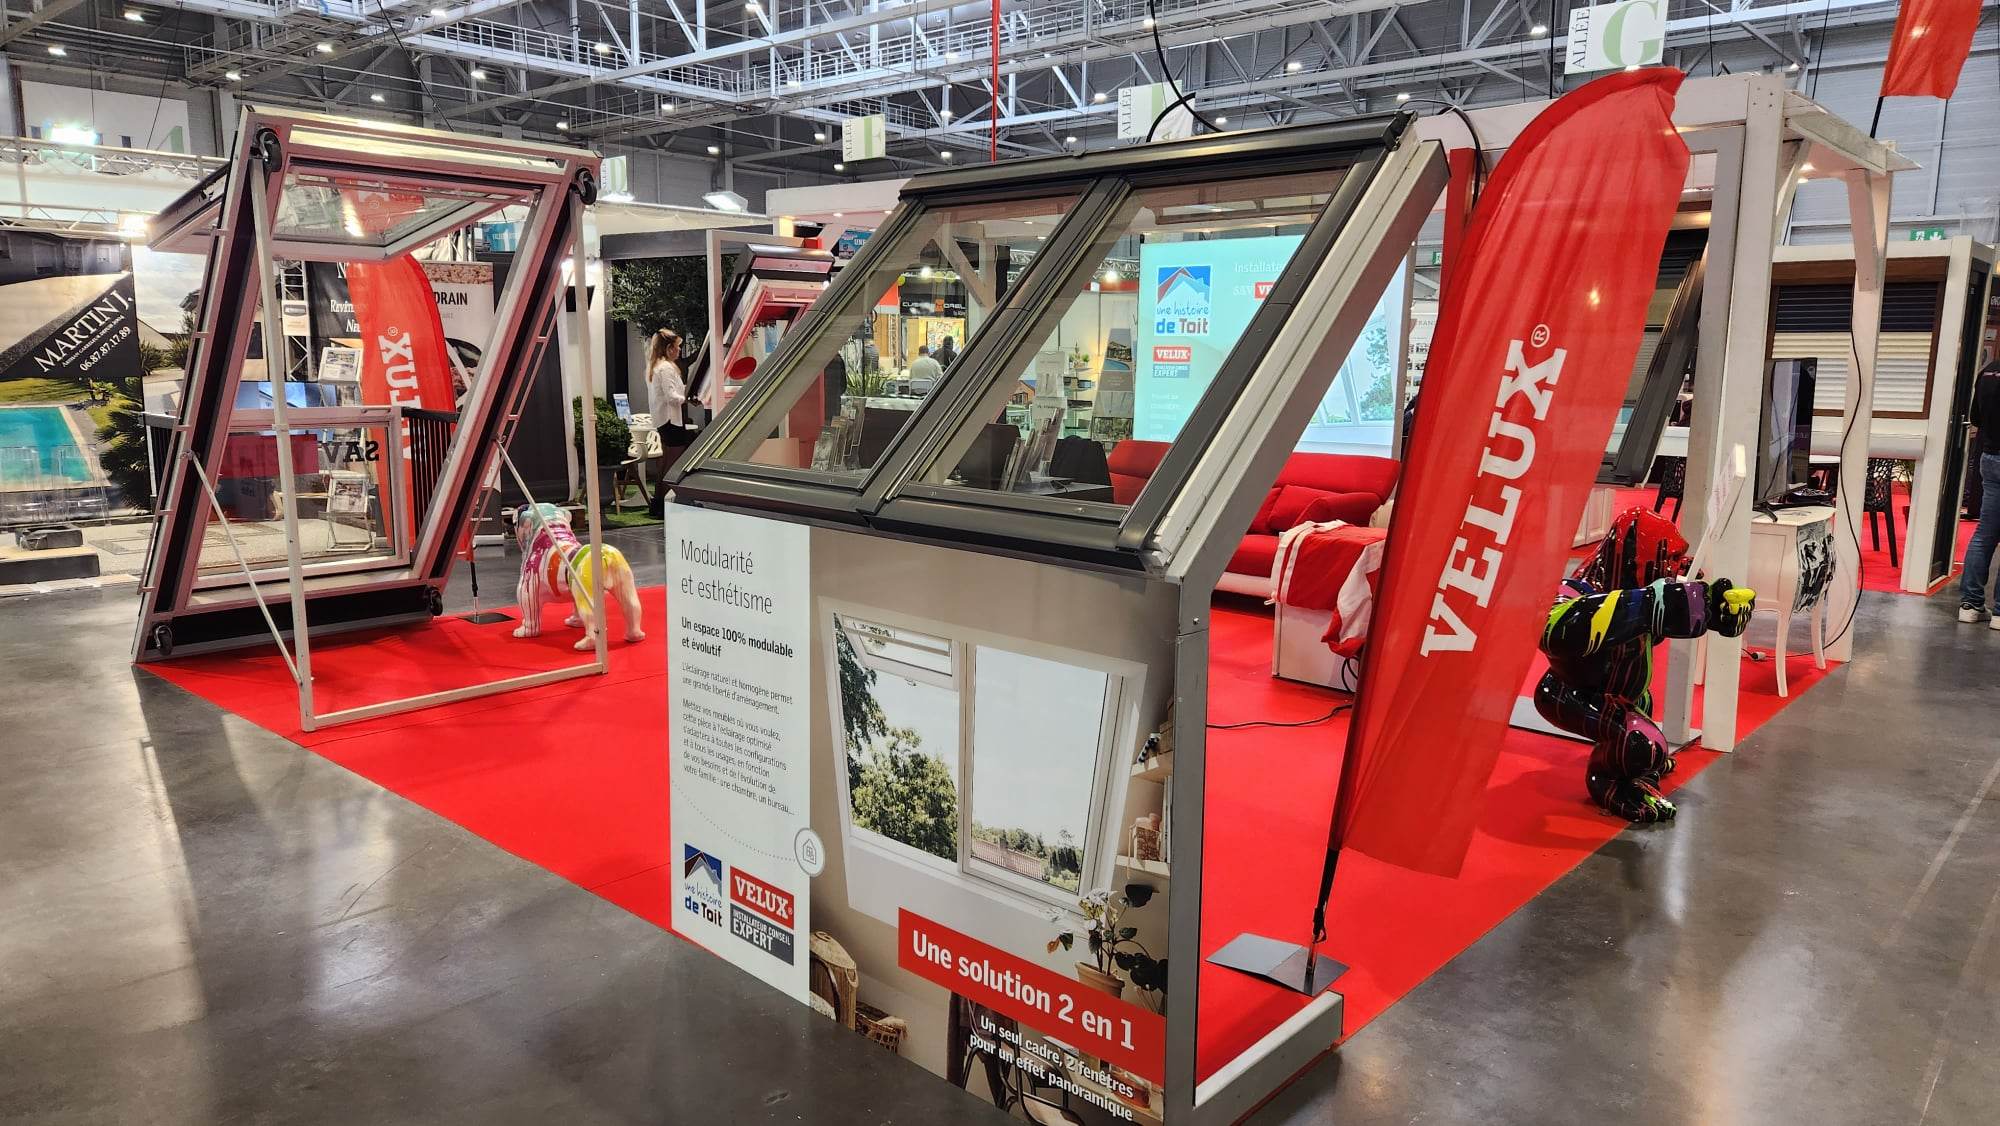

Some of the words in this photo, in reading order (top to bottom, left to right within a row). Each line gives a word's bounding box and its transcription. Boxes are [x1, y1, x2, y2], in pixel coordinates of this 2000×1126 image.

[1572, 9, 1591, 68] ALLÉE
[1602, 0, 1663, 67] G
[1156, 306, 1171, 316] une
[1174, 301, 1209, 316] histoire
[1156, 318, 1175, 334] de
[1179, 318, 1208, 334] Toit
[33, 297, 120, 372] MARTIN
[79, 326, 132, 371] 06.87.87.17.89
[1156, 349, 1188, 360] VELUX
[681, 539, 753, 575] Modularité
[681, 574, 694, 595] et
[697, 580, 772, 614] esthétisme
[681, 616, 692, 630] Un
[693, 621, 720, 638] espace
[721, 627, 746, 646] 100%
[748, 637, 793, 658] modulable
[682, 636, 690, 648] et
[691, 638, 722, 657] évolutif
[682, 662, 710, 679] L'éclairage
[711, 672, 730, 685] naturel
[731, 679, 738, 688] et
[738, 680, 769, 698] homogène
[770, 691, 793, 705] permet
[682, 677, 692, 686] une
[693, 679, 711, 693] grande
[712, 685, 731, 699] liberté
[682, 699, 701, 713] Mettez
[702, 706, 712, 717] vos
[713, 710, 736, 726] meubles
[745, 722, 759, 733] vous
[682, 713, 697, 724] cette
[697, 717, 712, 731] pièce
[746, 735, 772, 752] optimisé
[683, 739, 689, 747] et
[694, 742, 707, 754] tous
[707, 747, 715, 757] les
[737, 759, 745, 768] en
[745, 761, 770, 778] fonction
[683, 750, 691, 759] de
[691, 754, 700, 764] vos
[700, 757, 721, 773] besoins
[721, 767, 728, 775] et
[729, 769, 737, 779] de
[768, 784, 776, 794] de
[715, 737, 734, 751] toutes
[734, 744, 743, 755] les
[743, 748, 787, 771] configurations
[683, 765, 697, 776] votre
[698, 768, 717, 784] famille
[720, 780, 731, 790] une
[758, 795, 767, 803] un
[684, 895, 699, 914] de
[701, 902, 722, 927] Toit
[732, 908, 767, 934] INSTALLATEUR
[768, 926, 791, 946] CONSEIL
[733, 918, 773, 951] EXPERT
[912, 929, 952, 970] Une
[958, 956, 1050, 1014] solution
[1058, 993, 1074, 1024] 2
[1082, 1009, 1112, 1041] en
[1120, 1018, 1135, 1051] 1
[980, 1014, 996, 1034] Un
[998, 1023, 1022, 1047] seul
[1025, 1036, 1063, 1066] cadre,
[1066, 1055, 1078, 1073] 2
[1077, 1060, 1134, 1099] fenêtres
[969, 1033, 996, 1055] pour
[998, 1047, 1014, 1064] un
[1016, 1053, 1045, 1080] effet
[1048, 1071, 1133, 1122] panoramique
